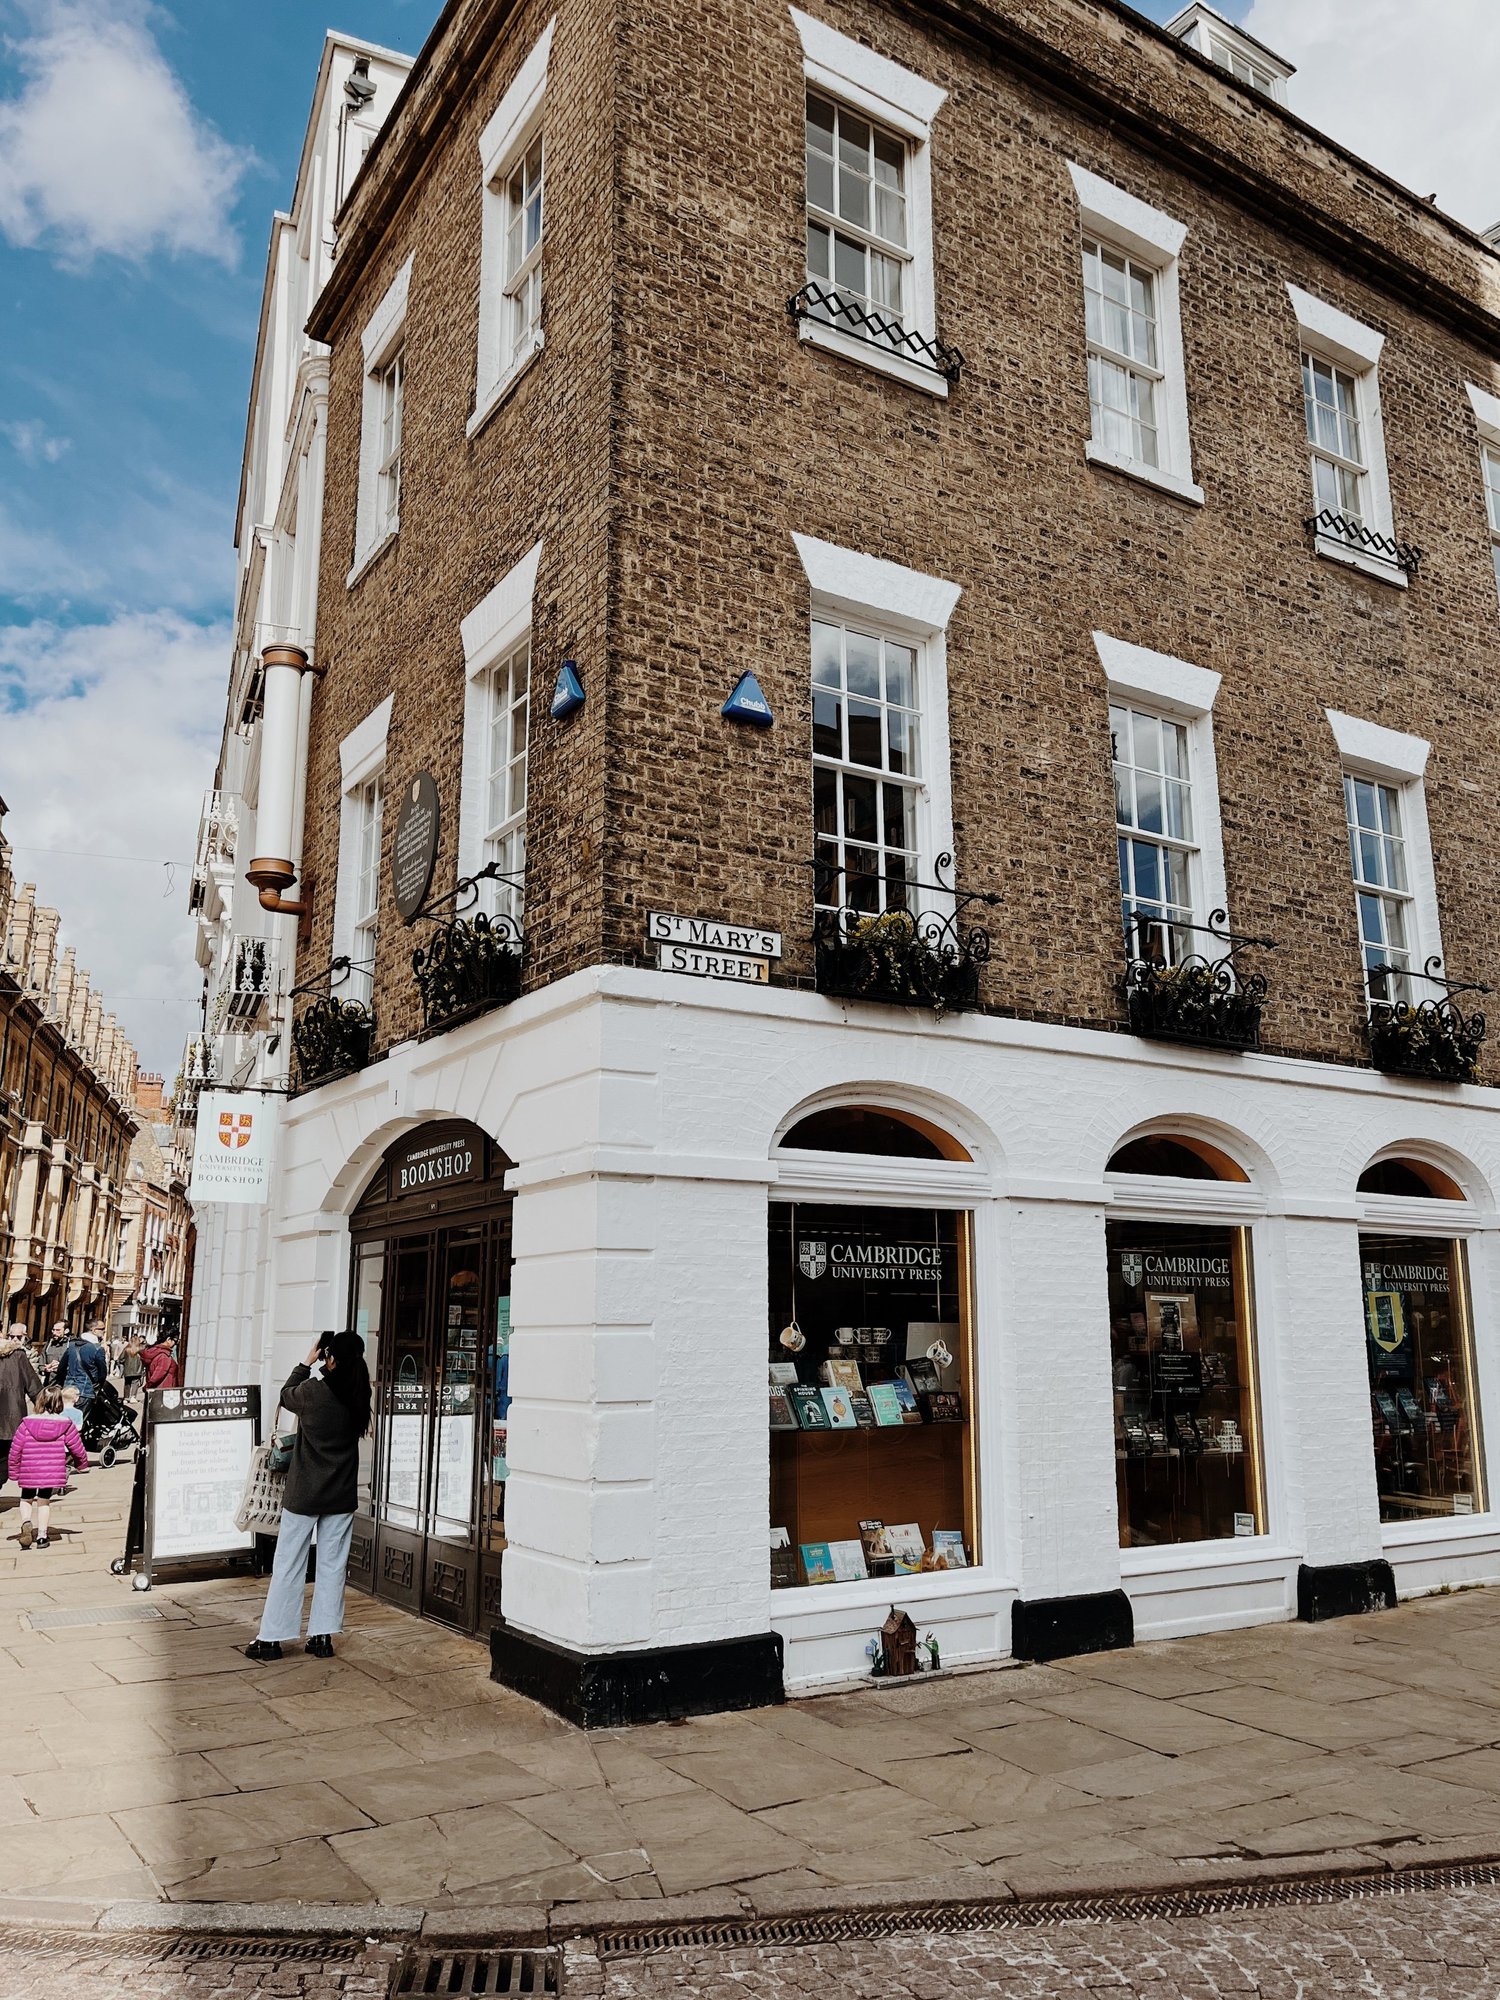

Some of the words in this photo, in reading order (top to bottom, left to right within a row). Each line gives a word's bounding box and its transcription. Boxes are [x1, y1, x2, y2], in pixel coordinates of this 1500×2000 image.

[740, 697, 766, 710] Chubb
[688, 920, 774, 952] MARY'S
[671, 947, 765, 980] STREET
[406, 1149, 429, 1162] CAMBRIDGE
[429, 1142, 452, 1156] UNIVERSITY
[452, 1139, 466, 1149] PRESS
[199, 1153, 265, 1166] CAMBRIDGE
[199, 1164, 242, 1172] UNIVERSITY
[400, 1151, 472, 1188] BOOKSHOP
[198, 1174, 263, 1185] BOOKSHOP
[830, 1244, 942, 1266] CAMBRIDGE
[1145, 1256, 1230, 1274] CAMBRIDGE
[832, 1266, 906, 1279] UNIVERSITY
[909, 1269, 942, 1280] PRESS
[1383, 1264, 1450, 1280] CAMBRIDGE
[1146, 1275, 1202, 1286] UNIVERSITY
[1205, 1277, 1230, 1287] PRESS
[1384, 1282, 1429, 1292] UNIVERSITY
[1430, 1283, 1450, 1293] PRESS
[183, 1388, 248, 1399] CAMBRIDGE
[184, 1398, 226, 1406] UNIVERSITY
[183, 1406, 248, 1418] BOOKSHOP
